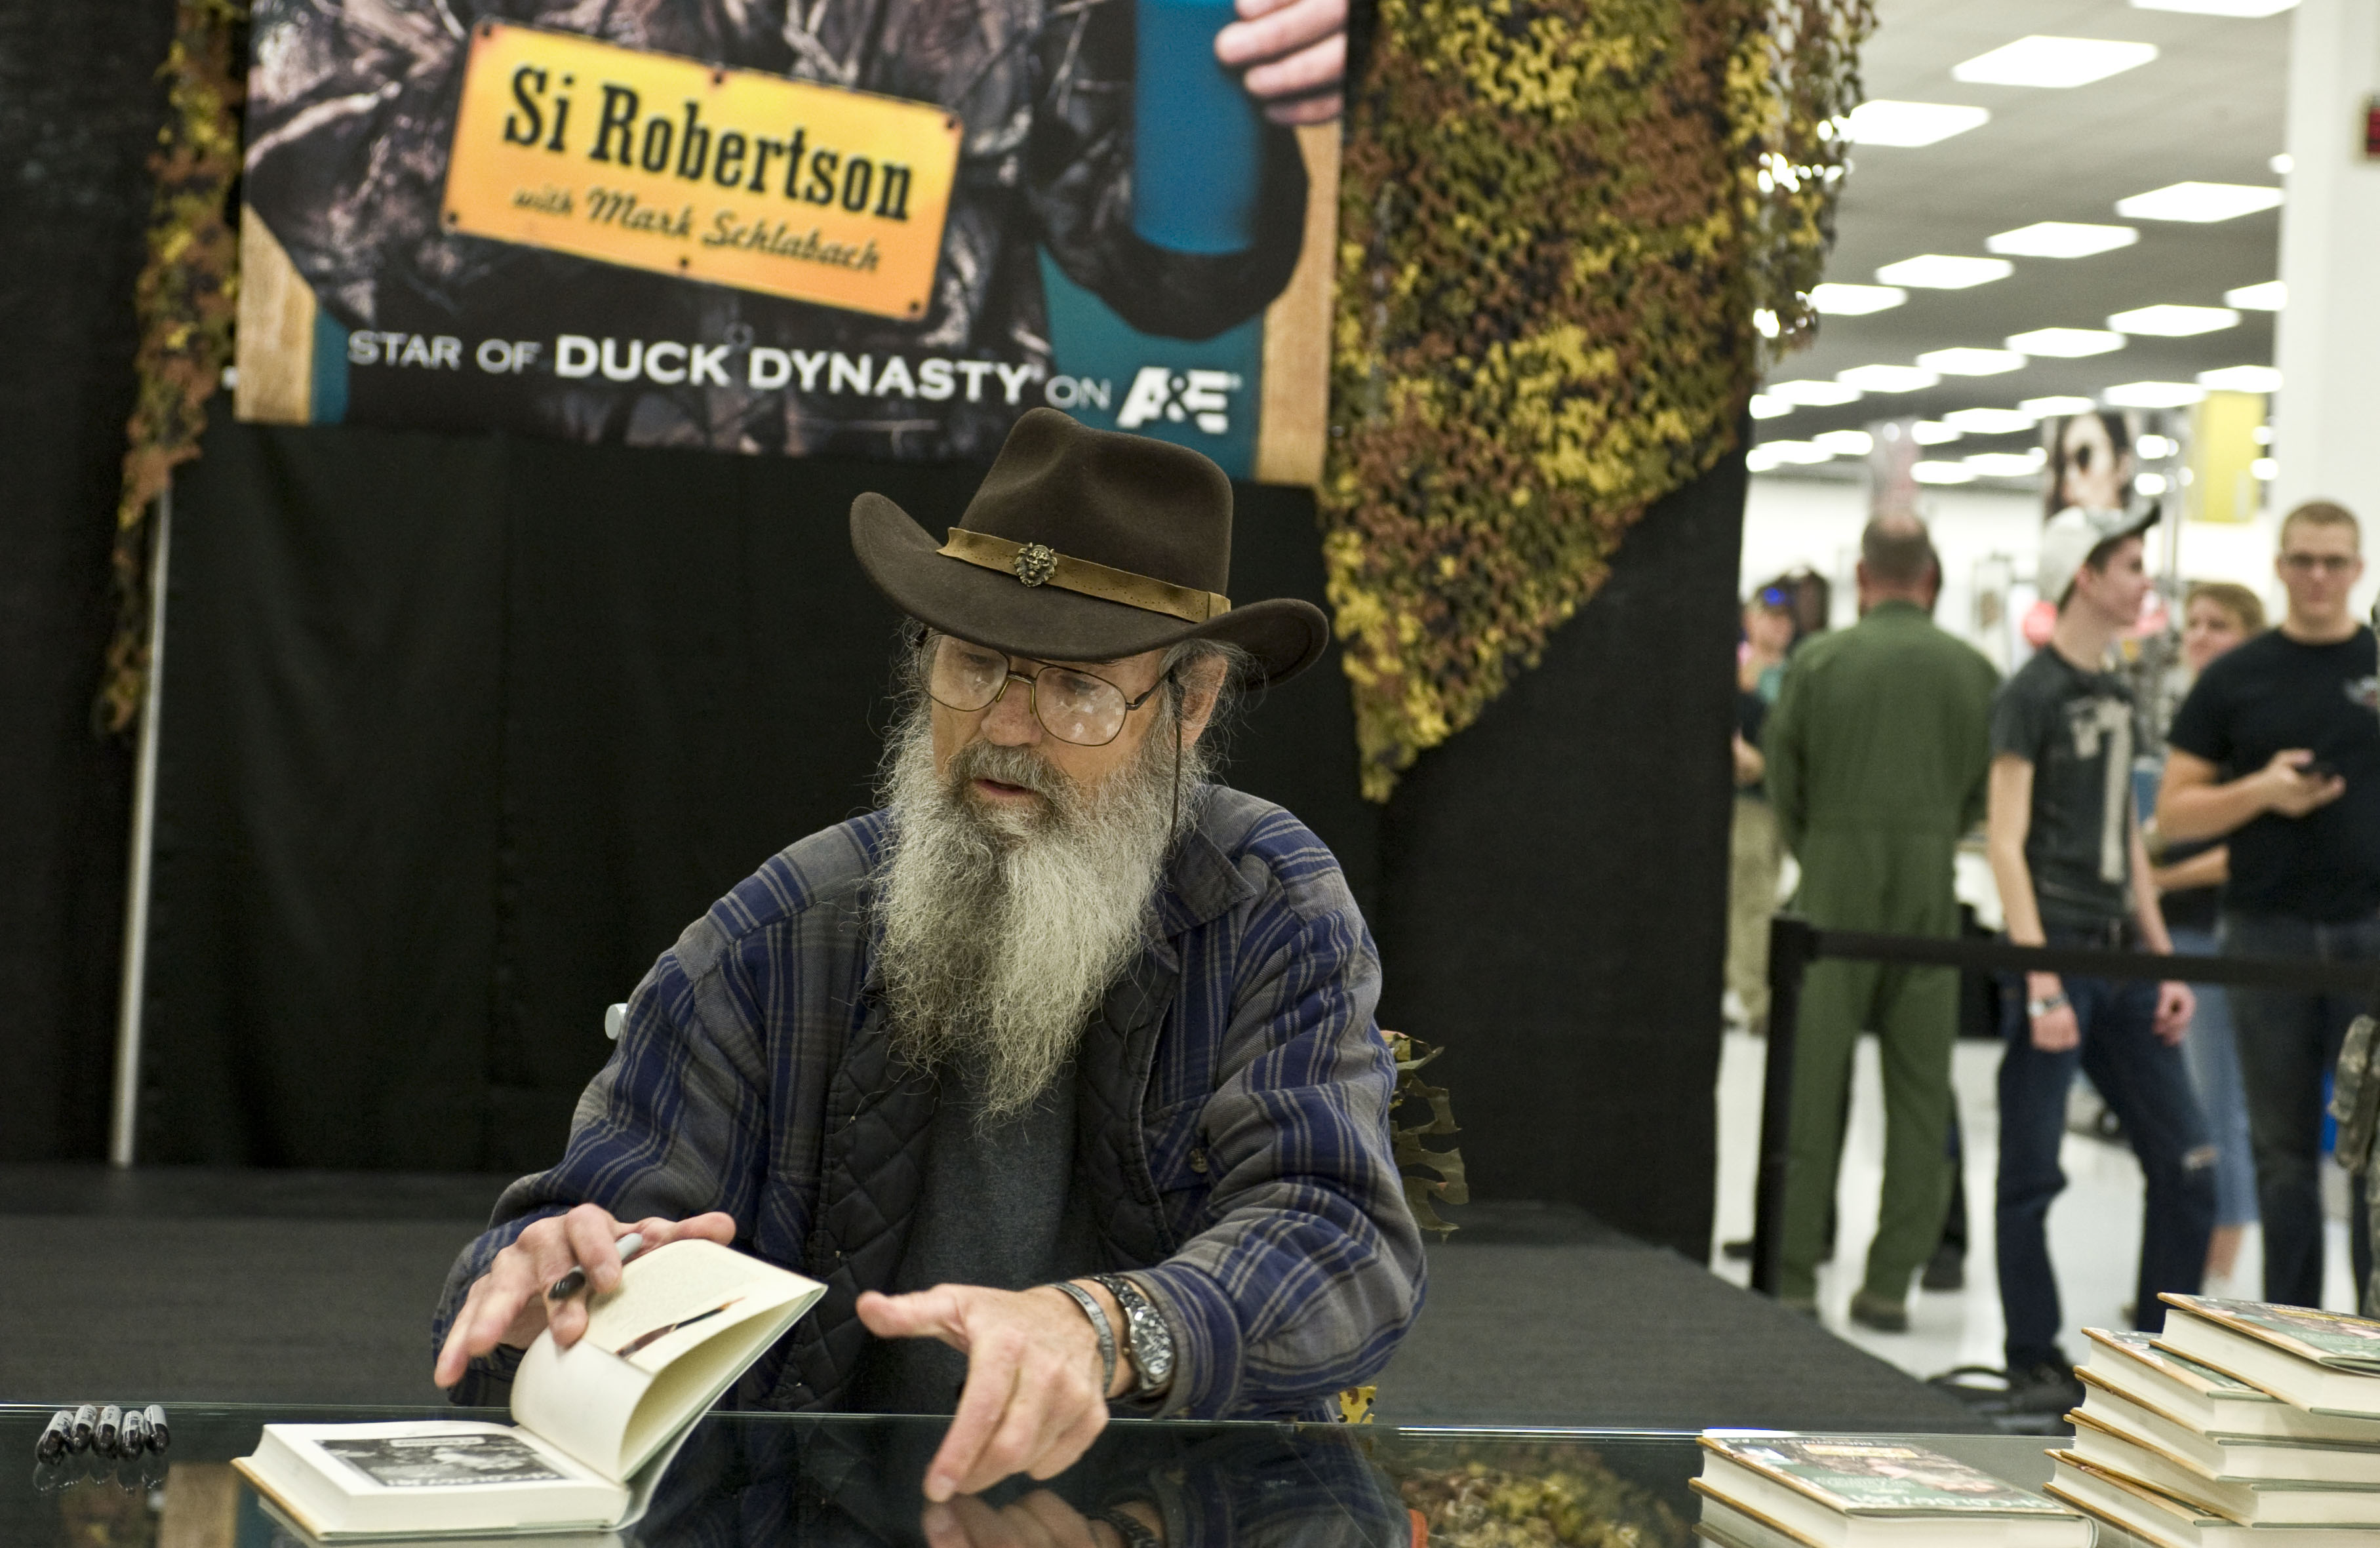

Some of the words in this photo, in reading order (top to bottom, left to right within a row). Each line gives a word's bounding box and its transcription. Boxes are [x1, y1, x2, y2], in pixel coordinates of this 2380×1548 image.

[503, 65, 575, 153] Si
[588, 81, 912, 222] Robertson
[513, 184, 574, 216] with
[587, 187, 694, 237] Mark
[701, 209, 881, 272] Schlabach
[347, 329, 462, 371] STAR
[476, 338, 542, 374] OF
[555, 334, 732, 386] DUCK
[748, 346, 1032, 405] DYNASTY
[1045, 372, 1112, 410] ON
[1116, 366, 1229, 435] A&E
